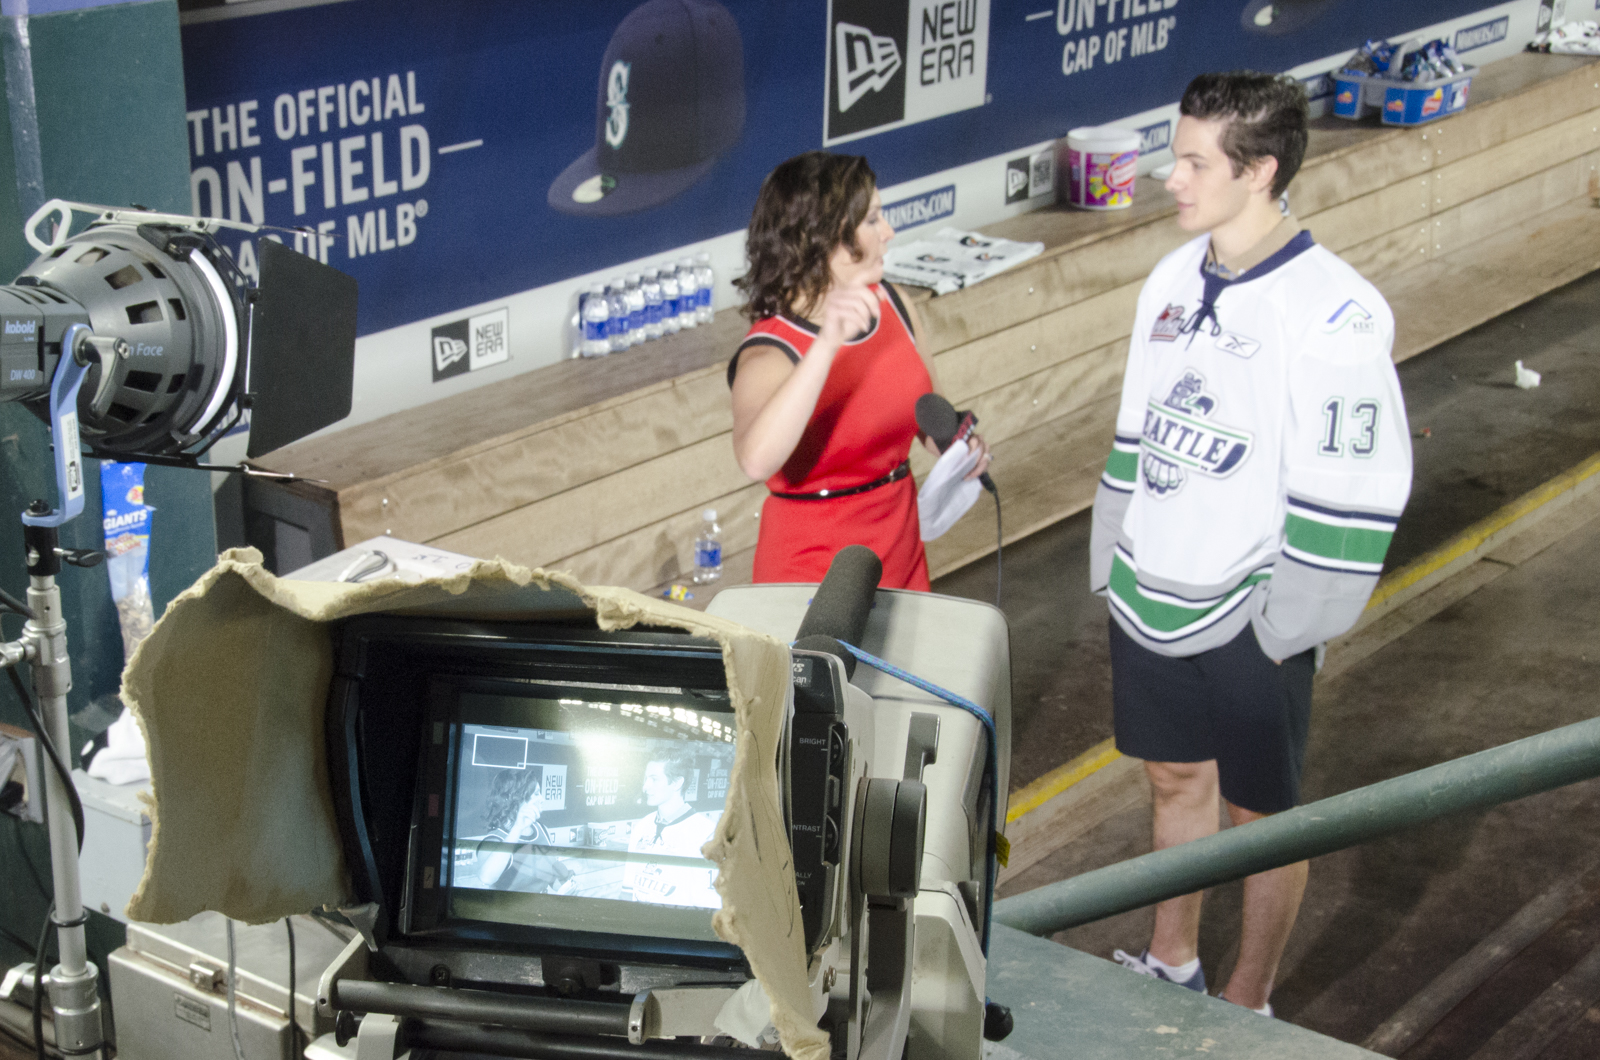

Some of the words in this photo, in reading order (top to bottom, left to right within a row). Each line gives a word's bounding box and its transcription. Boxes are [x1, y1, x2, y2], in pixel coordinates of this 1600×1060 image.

[921, 0, 977, 45] NEW
[920, 39, 975, 86] ERA
[1062, 35, 1101, 76] CAP
[1104, 28, 1128, 64] OF
[186, 100, 261, 156] THE
[274, 70, 426, 140] OFFICIAL
[190, 124, 430, 235] ON-FIELD
[5, 320, 36, 334] kobold
[475, 320, 504, 342] NEW
[137, 343, 164, 356] Face
[475, 336, 504, 357] ERA
[1318, 396, 1381, 459] 13
[103, 509, 148, 531] GIANTS
[799, 737, 827, 746] BRIGHT
[545, 774, 563, 788] NEW
[584, 778, 619, 794] ON-FIELD
[545, 788, 563, 801] ERA
[796, 871, 812, 879] ALLY
